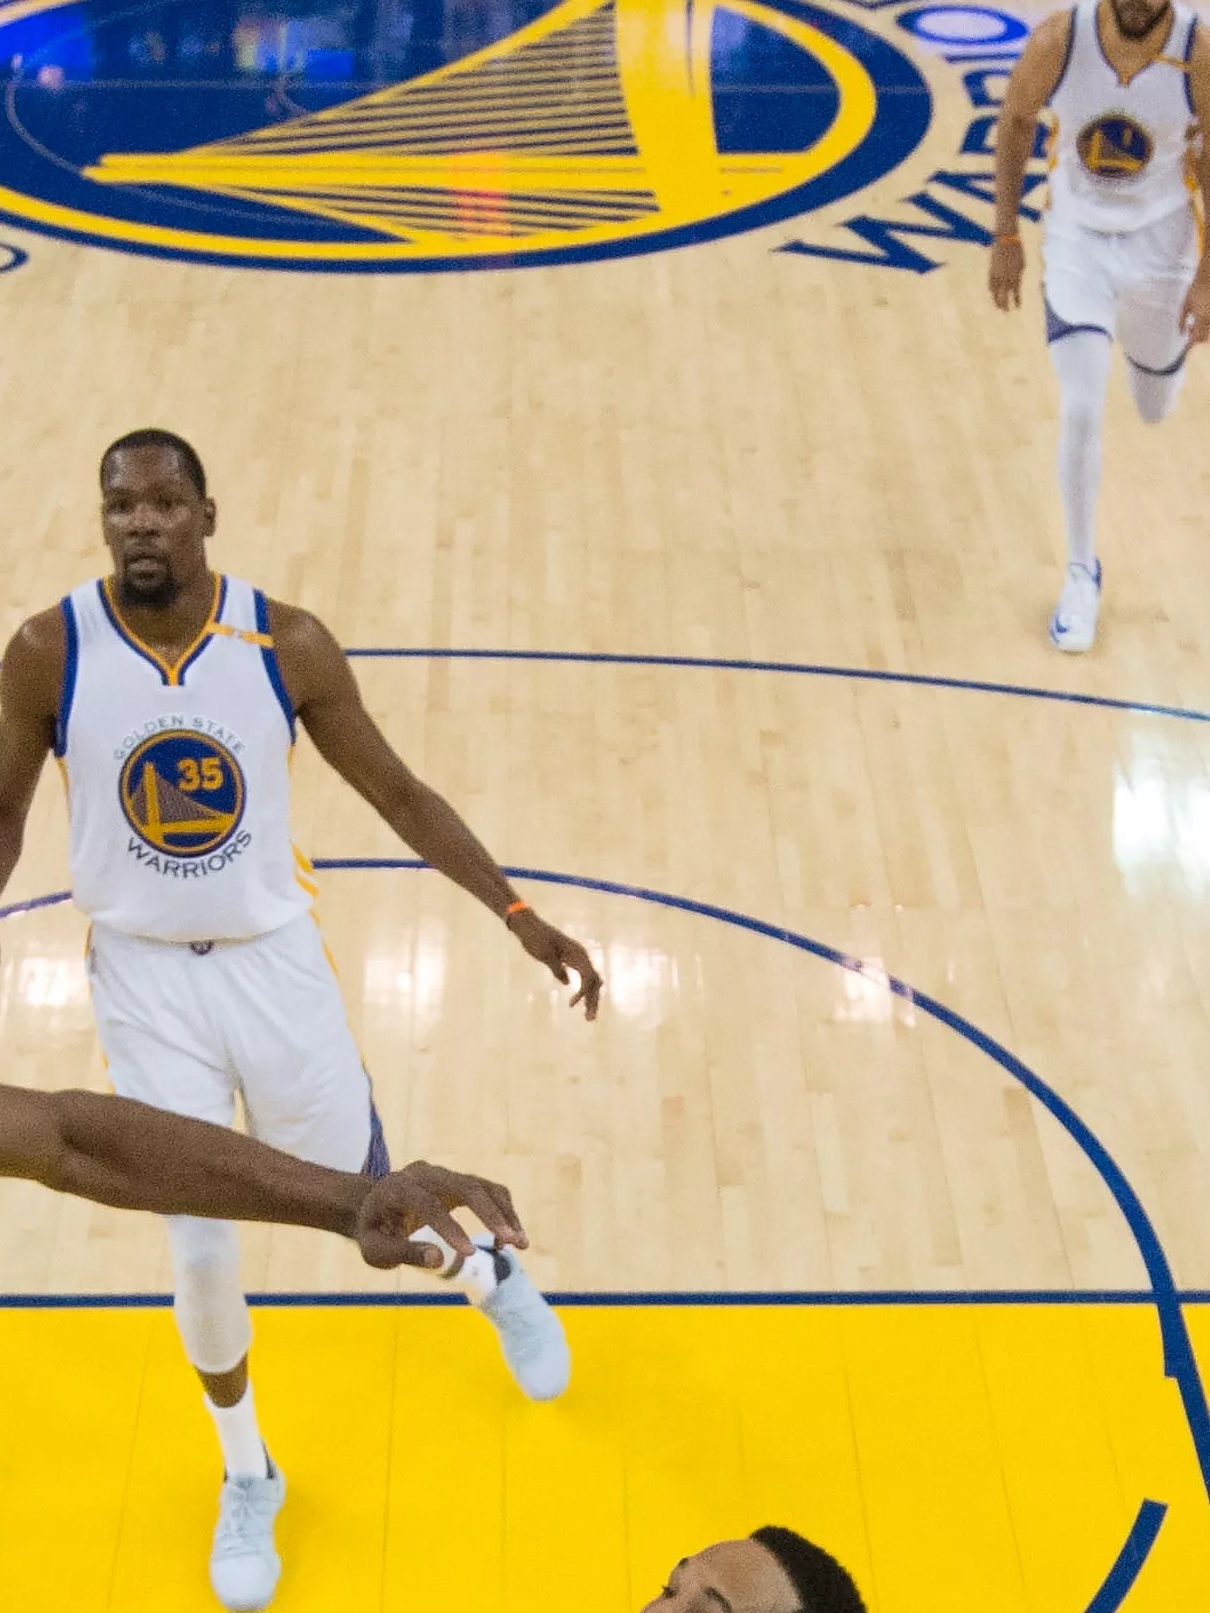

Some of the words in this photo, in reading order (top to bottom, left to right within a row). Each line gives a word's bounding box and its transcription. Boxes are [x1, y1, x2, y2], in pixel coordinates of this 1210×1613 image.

[113, 714, 184, 761] GOLDEN
[192, 716, 246, 751] STATE
[176, 757, 224, 791] 35
[127, 829, 252, 879] WARRIORS
